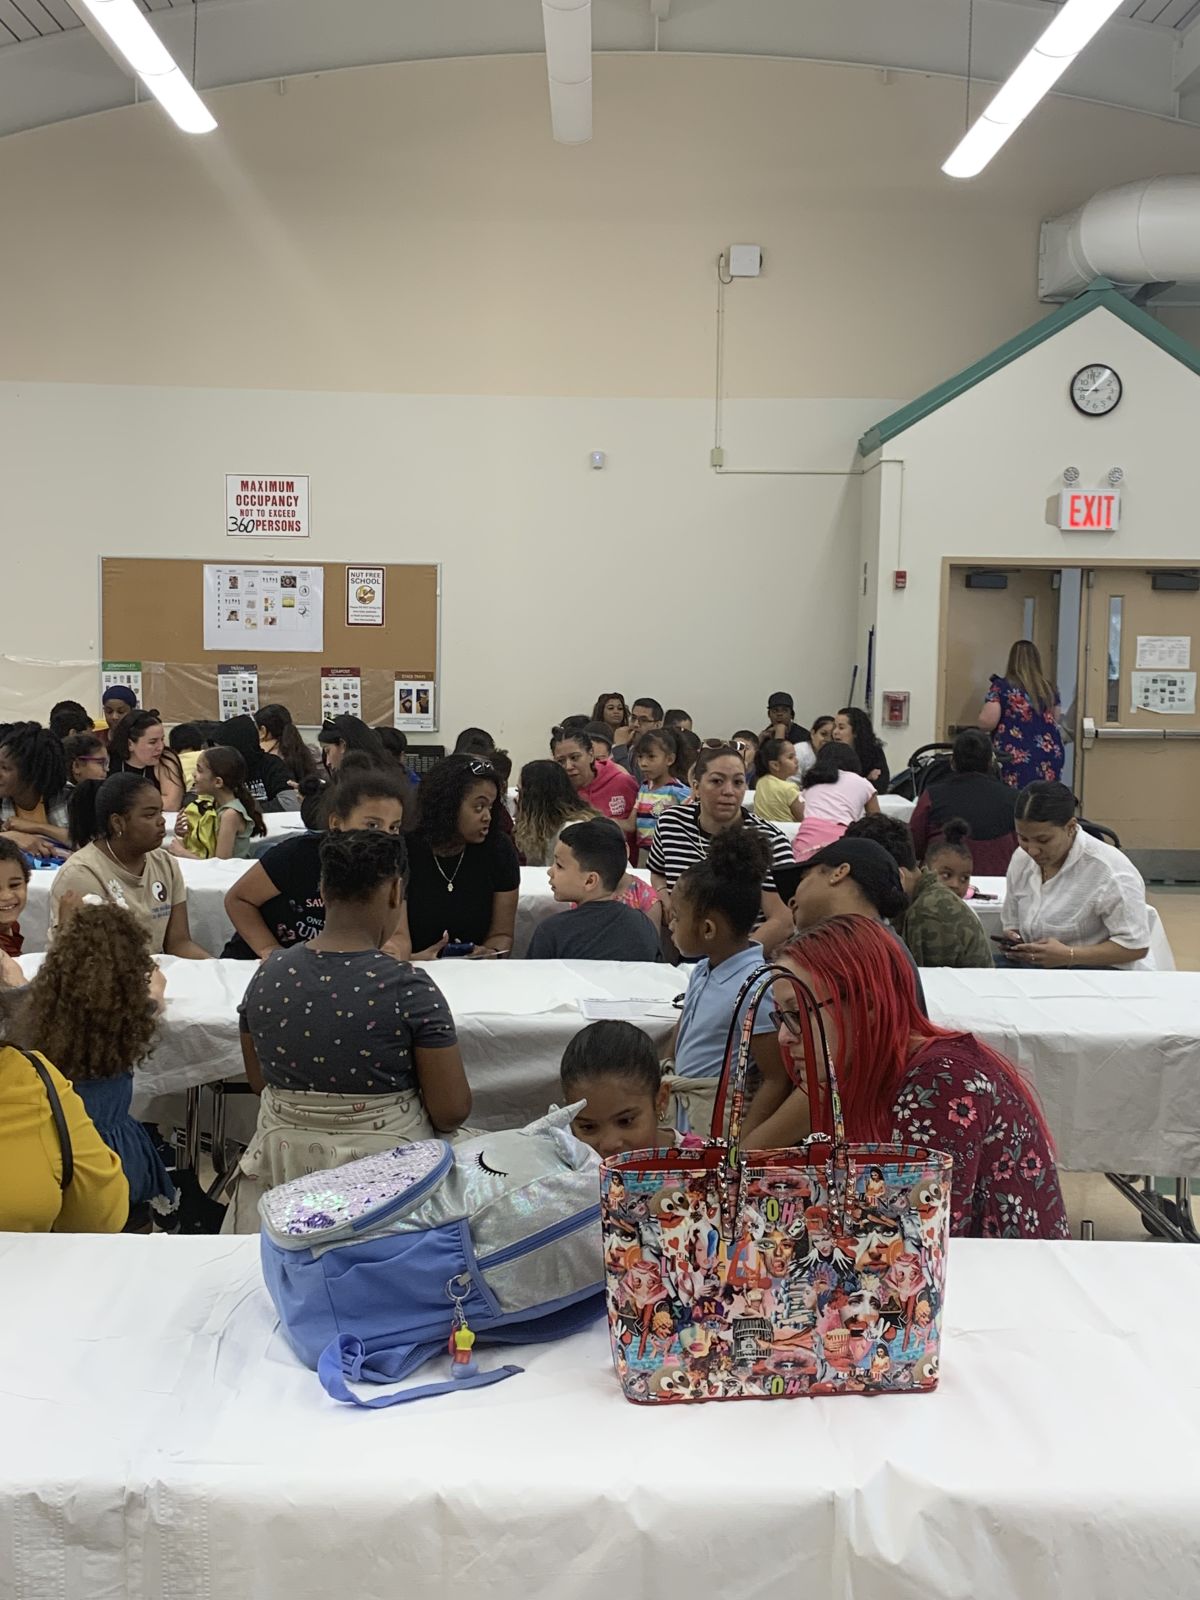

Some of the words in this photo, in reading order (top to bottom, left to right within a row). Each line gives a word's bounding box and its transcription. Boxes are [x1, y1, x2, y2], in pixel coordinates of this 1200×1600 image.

[240, 480, 295, 493] MAXIMUM
[236, 494, 299, 507] OCCUPANCY
[239, 508, 254, 517] NOT
[256, 509, 266, 518] TO
[268, 509, 297, 518] EXCEED
[1069, 494, 1115, 528] EXIT
[228, 516, 256, 534] 360
[255, 519, 302, 532] PERSONS
[350, 577, 382, 585] SCHOOL
[305, 898, 325, 908] SAV
[306, 915, 326, 926] ONL
